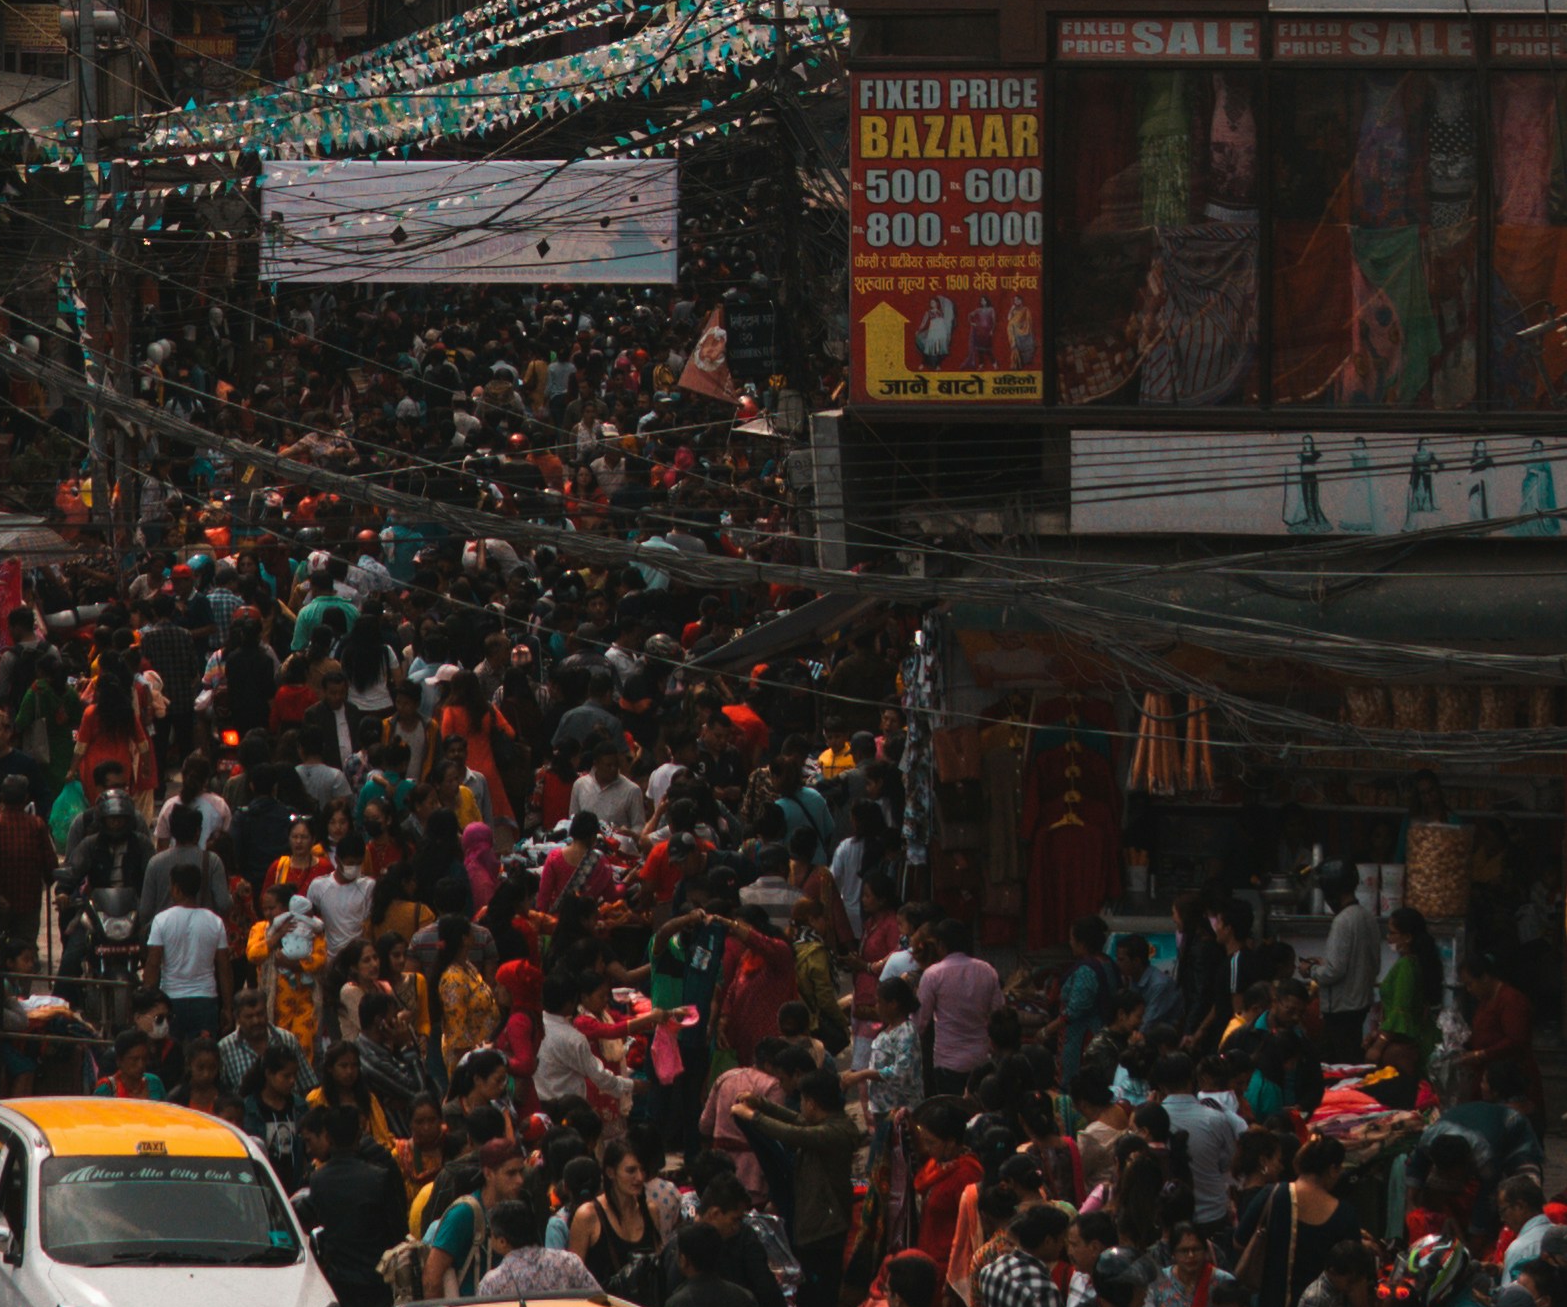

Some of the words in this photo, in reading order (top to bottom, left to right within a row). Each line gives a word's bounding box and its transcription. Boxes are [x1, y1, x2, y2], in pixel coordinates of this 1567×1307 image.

[1062, 22, 1125, 36] FIXED
[1132, 21, 1255, 55] SALE
[1062, 40, 1126, 54] PRICE
[1278, 23, 1342, 37] FIXED
[1348, 22, 1472, 55] SALE
[1278, 41, 1343, 55] PRICE
[859, 79, 940, 110] FIXED
[950, 78, 1037, 108] PRICE
[860, 114, 1039, 159] BAZAAR
[964, 168, 1042, 203] 600
[963, 211, 1043, 246] 1000
[945, 274, 970, 290] 1500
[879, 375, 929, 395] जाने
[937, 375, 985, 395] बाटो
[143, 1141, 166, 1152] TAXI
[130, 1167, 164, 1179] Alto
[170, 1167, 199, 1181] City
